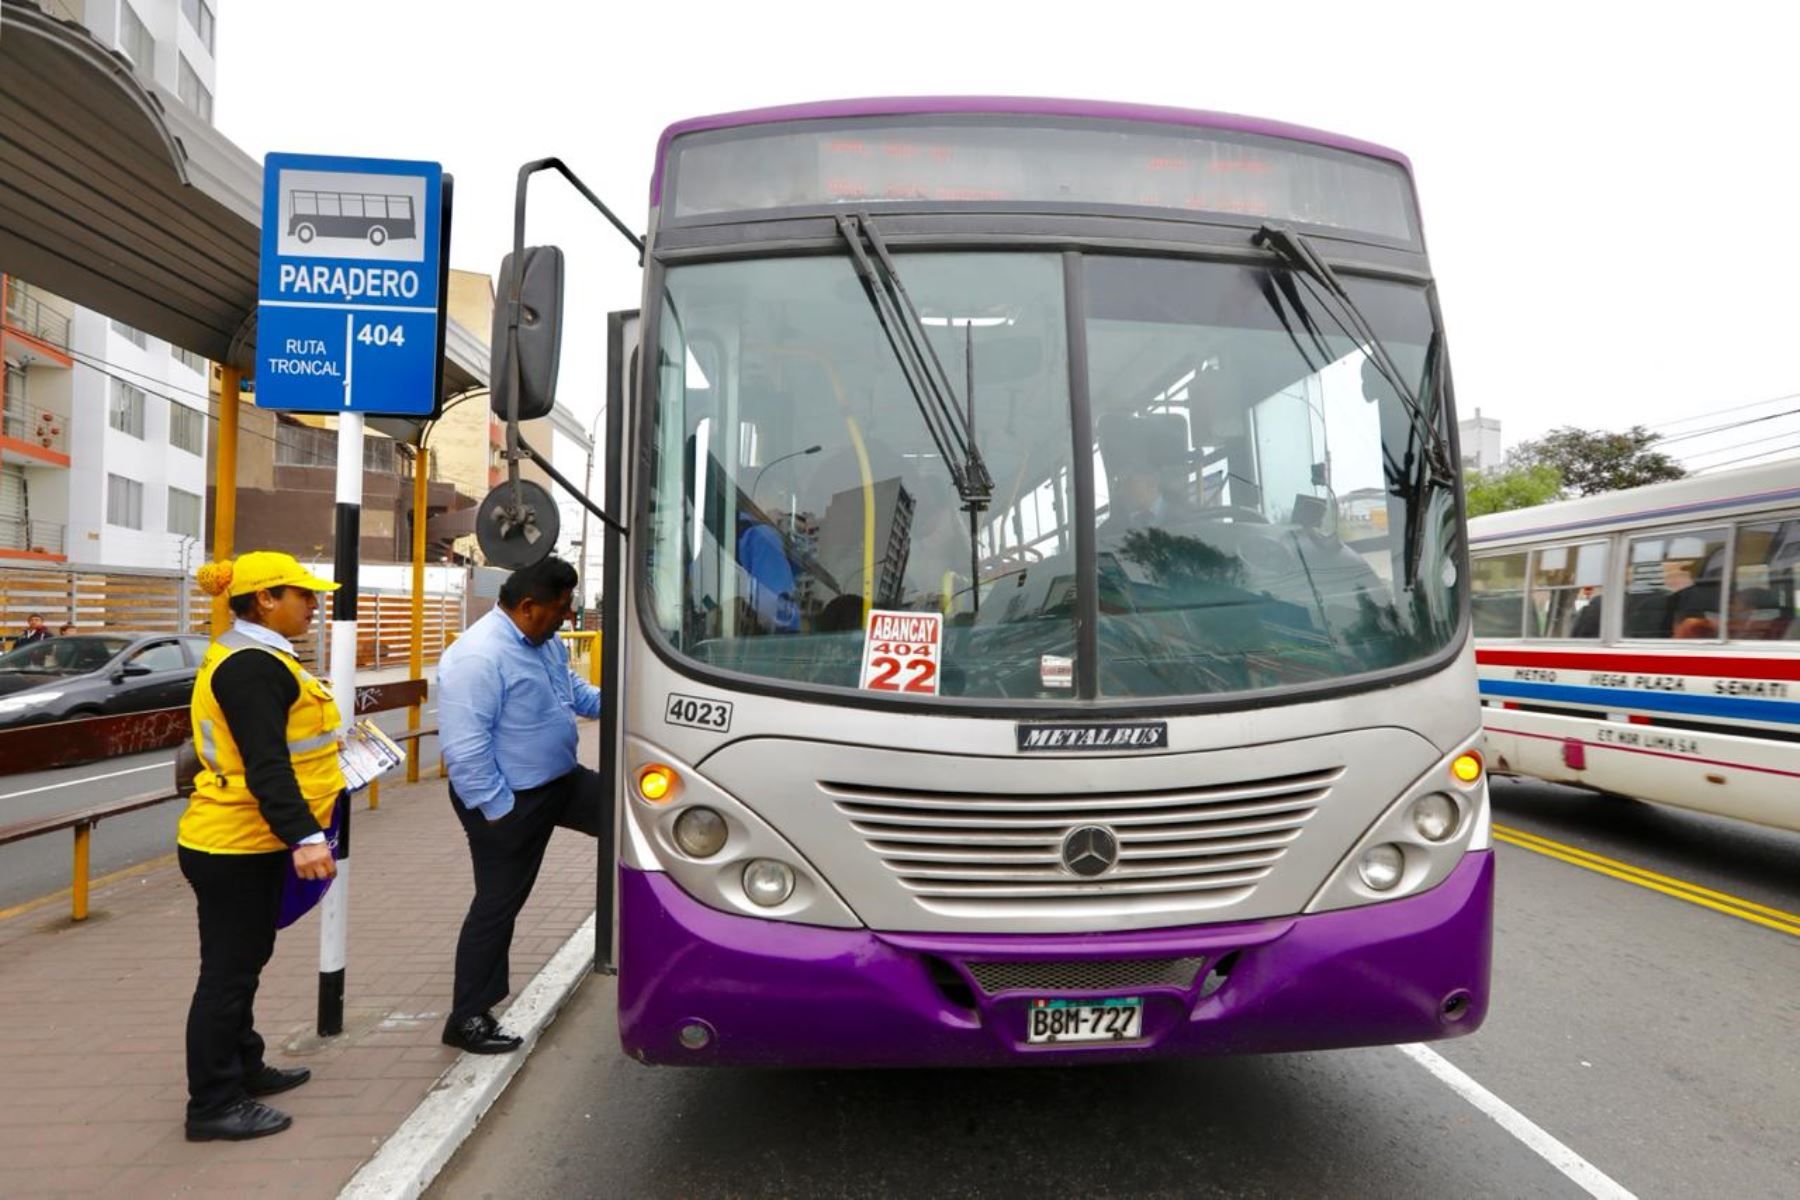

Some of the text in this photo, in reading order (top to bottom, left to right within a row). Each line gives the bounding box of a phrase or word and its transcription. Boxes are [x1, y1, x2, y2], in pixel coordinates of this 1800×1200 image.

[279, 264, 420, 299] PARADERO
[357, 323, 406, 347] 404
[286, 339, 327, 355] RUTA
[268, 358, 341, 377] TRONCAL
[872, 616, 936, 643] ABANCAY
[873, 643, 932, 657] 404
[867, 656, 937, 693] 22
[1514, 669, 1557, 683] METRO
[1634, 676, 1686, 692] PLAZA
[1714, 680, 1789, 698] SENATI
[670, 699, 727, 727] 4023
[1023, 727, 1163, 747] METALBUS
[1033, 1006, 1136, 1036] B8M-727
